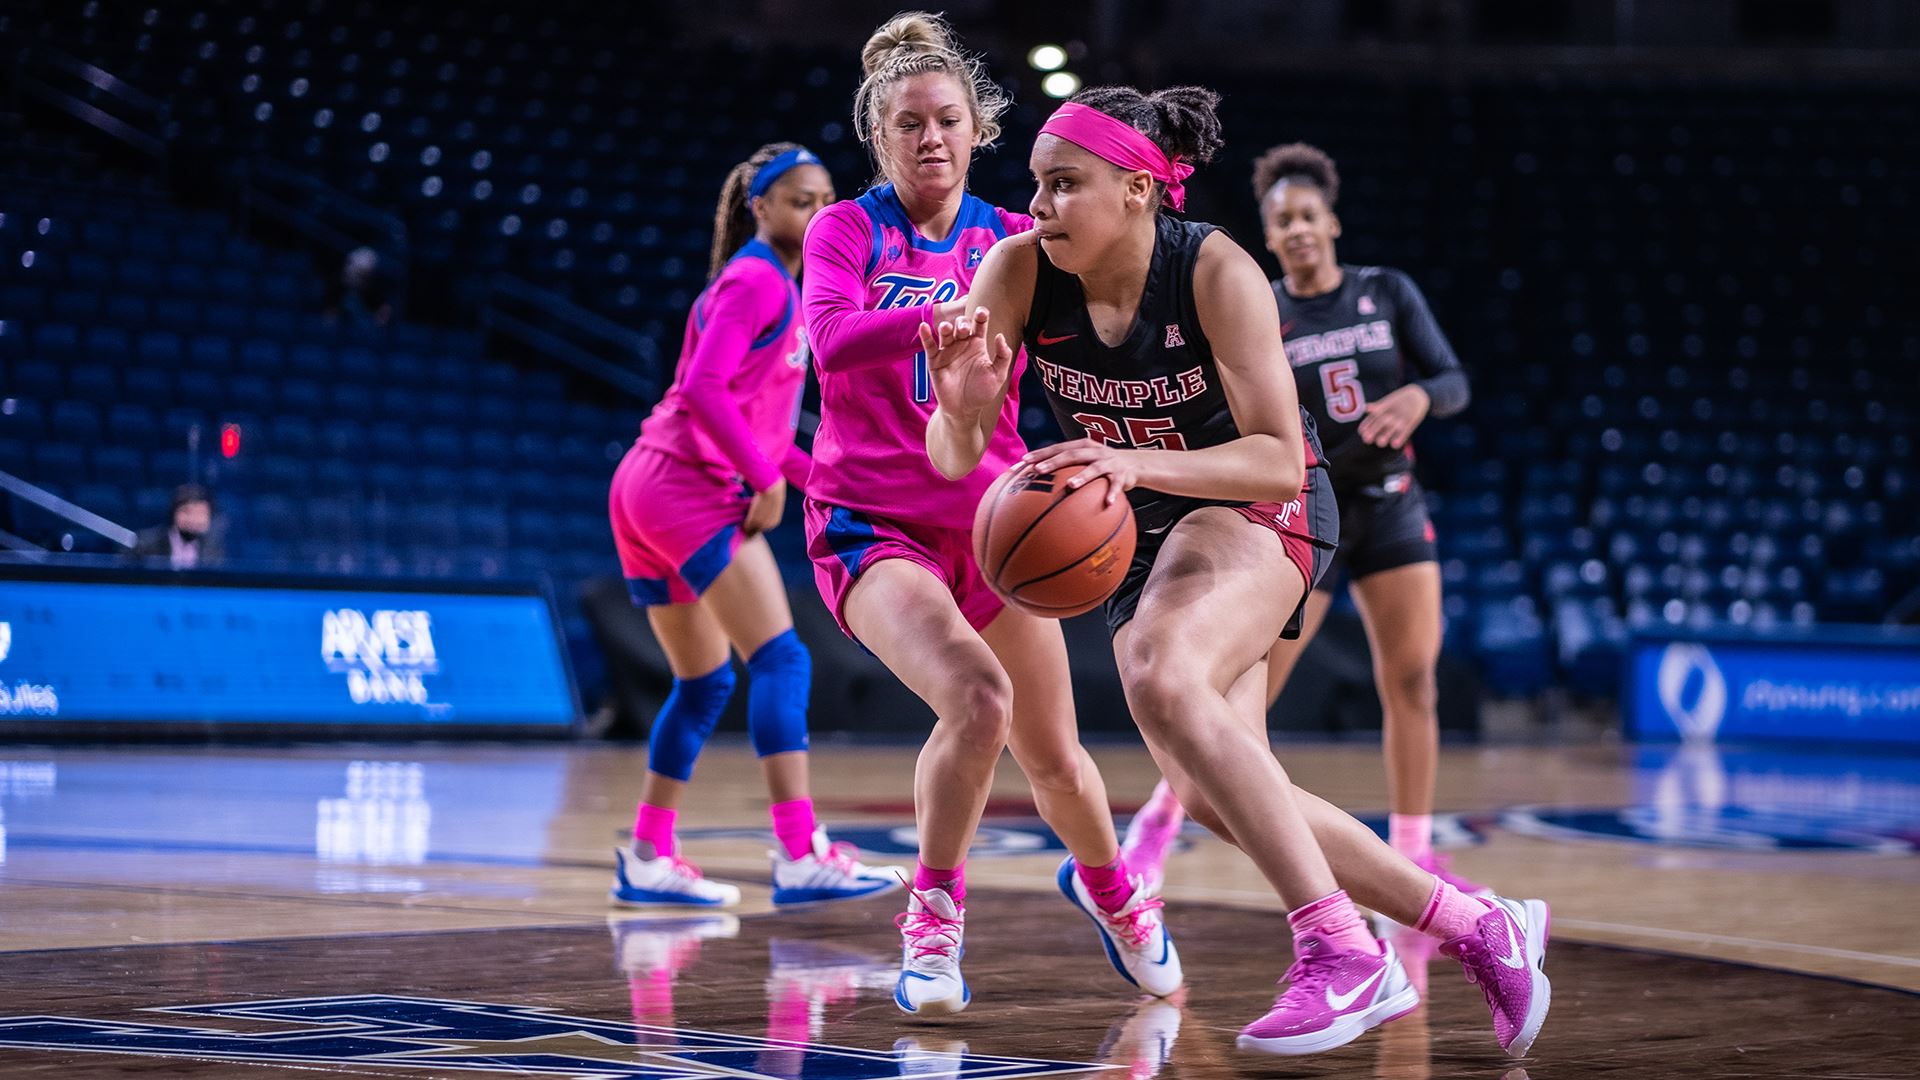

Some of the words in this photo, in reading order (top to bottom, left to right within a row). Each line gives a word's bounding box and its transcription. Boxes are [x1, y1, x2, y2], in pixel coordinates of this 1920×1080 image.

[1035, 355, 1208, 409] TEMPLE
[1318, 357, 1368, 424] 5
[0, 679, 60, 715] uites
